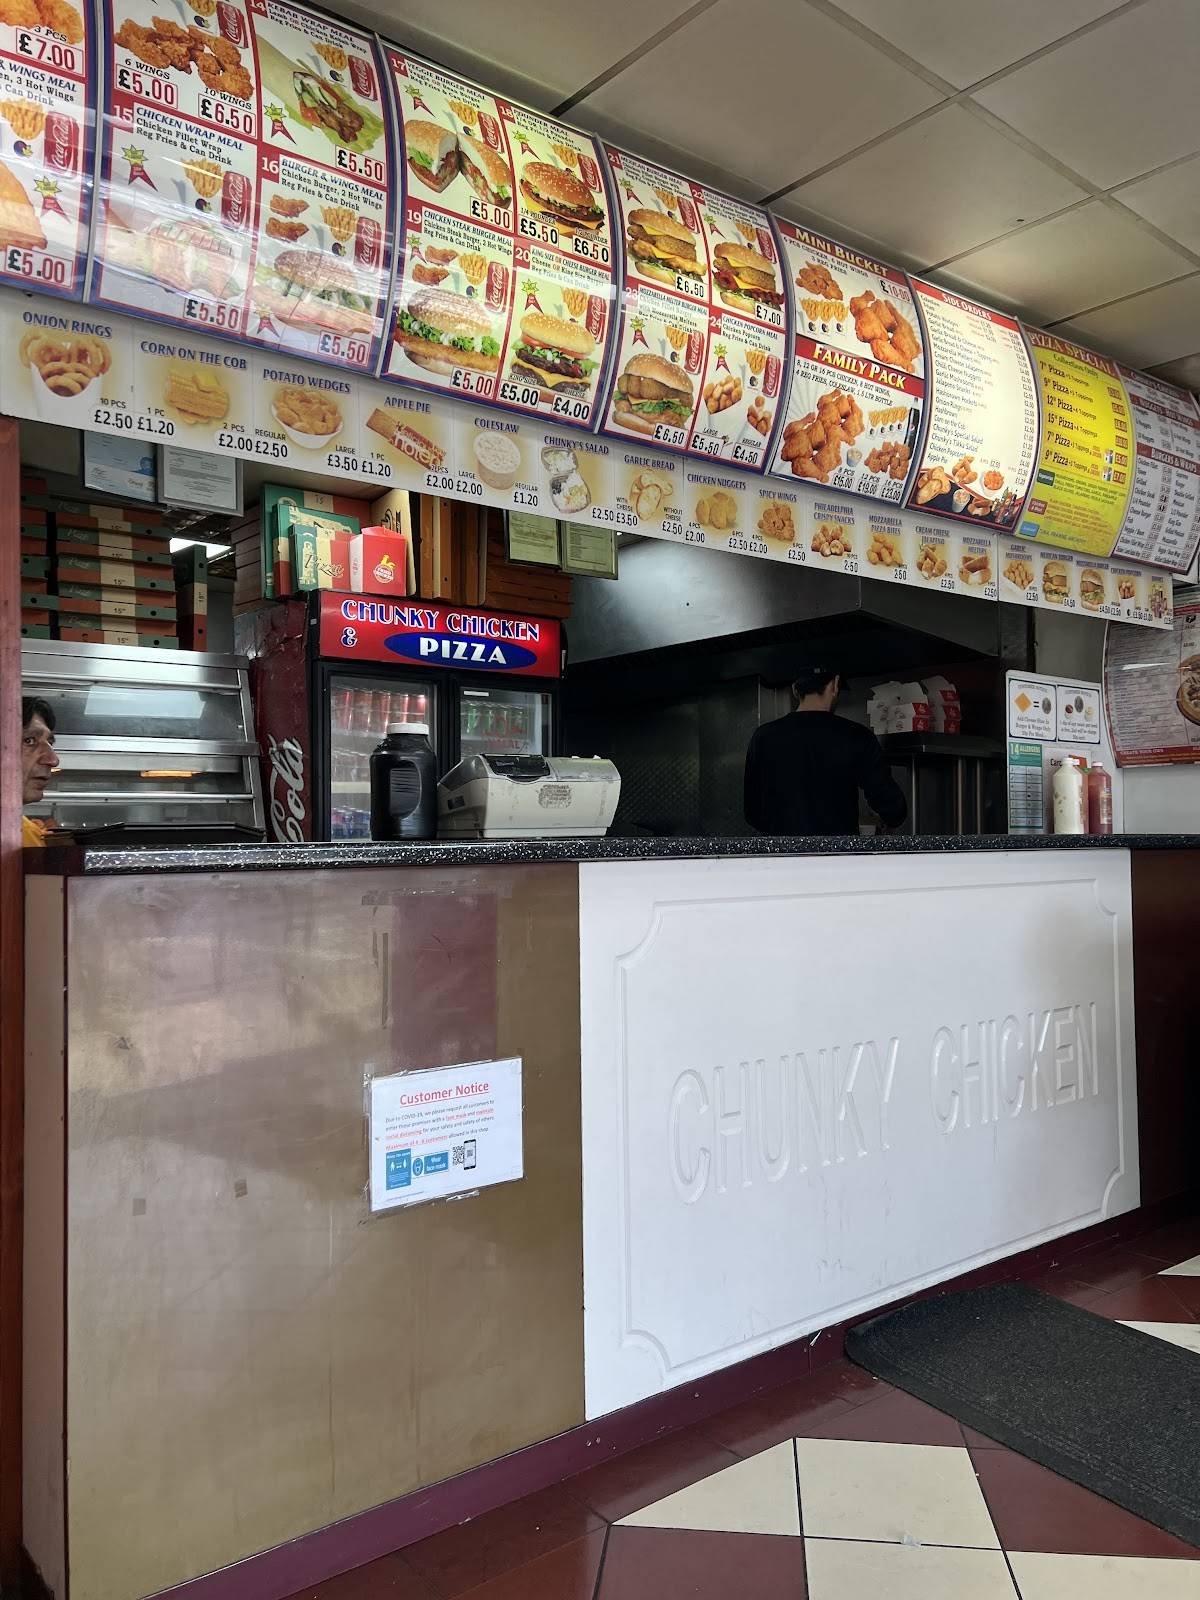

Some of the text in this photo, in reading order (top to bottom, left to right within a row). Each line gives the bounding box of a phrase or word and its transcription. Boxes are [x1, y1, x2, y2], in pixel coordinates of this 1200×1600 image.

[18, 34, 75, 70] £7.00
[10, 64, 45, 81] WINGS
[48, 76, 77, 92] MEAL
[118, 69, 174, 105] £5.00
[204, 87, 252, 110] 10 WINGS
[114, 105, 132, 122] 15
[201, 99, 252, 134] £6.50
[137, 107, 244, 150] CHICKEN WRAP MEAL
[137, 118, 222, 154] Chicken Fillet Wrap
[262, 157, 279, 174] 16
[338, 150, 383, 181] £5.50
[282, 159, 384, 201] BURGER & WINGS MEAL
[407, 210, 421, 224] 19
[472, 200, 510, 229] £5.00
[424, 210, 512, 247] CHICKEN STEAK BURGER MEAL
[520, 218, 558, 244] £5.50
[516, 247, 530, 262] 20
[574, 238, 609, 262] £6.50
[795, 228, 888, 276] MINI BUCKET
[7, 249, 65, 283] £5.00
[626, 287, 637, 300] 23
[677, 277, 704, 298] £6.50
[186, 300, 238, 329] £5.50
[756, 305, 781, 325] £7.00
[942, 293, 992, 321] SIDE ORDERS
[23, 311, 112, 338] ONION RINGS
[710, 317, 721, 327] 24
[723, 316, 778, 340] CHICKEN POPCORN MEAL
[140, 341, 247, 369] CORN ON THE COB
[321, 334, 365, 363] £5.50
[813, 343, 906, 389] FAMILY PACK
[263, 369, 351, 393] POTATO WEDGES
[452, 370, 493, 396] £5.00
[100, 397, 126, 409] 10 PCS
[500, 384, 538, 405] £5.00
[385, 396, 431, 413] APPLE PIE
[553, 397, 590, 420] £4.00
[1058, 398, 1072, 412] Pizza
[95, 409, 132, 429] £2.50
[137, 418, 174, 436] £1.20
[475, 417, 520, 433] COLESLAW
[1059, 416, 1074, 430] Pizza
[219, 433, 253, 451] £2.00
[255, 429, 286, 440] REGULAR
[655, 424, 684, 444] £6.50
[1055, 433, 1070, 448] Pizza
[256, 441, 288, 458] £2.50
[336, 445, 356, 455] LARGE
[544, 436, 609, 455] CHUNKY'S SALAD
[692, 434, 719, 455] £5.50
[328, 455, 358, 471] £3.50
[624, 455, 675, 471] GARLIC BREAD
[734, 446, 758, 464] £4.50
[1053, 452, 1068, 466] Pizza
[361, 460, 391, 478] £1.20
[459, 470, 476, 480] LARGE
[427, 475, 453, 490] £2.00
[456, 481, 482, 496] £2.00
[515, 483, 538, 492] REGULAR
[688, 474, 746, 490] CHICKEN NUGGETS
[833, 475, 852, 488] £15.00
[858, 481, 877, 494] £19.00
[514, 492, 538, 507] £1.20
[759, 489, 797, 502] SPICY WINGS
[881, 488, 900, 501] £23.00
[592, 507, 614, 521] £2.50
[616, 503, 633, 512] CHEESE
[664, 507, 683, 515] WITHOUT
[616, 512, 638, 526] £3.50
[665, 513, 681, 521] CHEESE
[662, 521, 683, 535] £2.50
[685, 530, 705, 543] £2.00
[729, 538, 747, 550] £2.50
[749, 542, 768, 554] £2.00
[788, 549, 806, 562] £2.50
[940, 579, 955, 590] £2.50
[984, 588, 996, 597] £2.50
[1026, 592, 1038, 601] £2.50
[1064, 598, 1075, 608] £4.50
[1099, 605, 1110, 614] £4.50
[1110, 607, 1121, 616] £2.50
[341, 599, 541, 642] CHUNKY CHICKEN
[341, 627, 507, 665] & PIZZA
[1010, 743, 1019, 755] 14
[268, 734, 306, 843] Cola
[400, 1082, 489, 1106] Customer Notice
[666, 1001, 1099, 1207] CHUNKY CHICKEN
